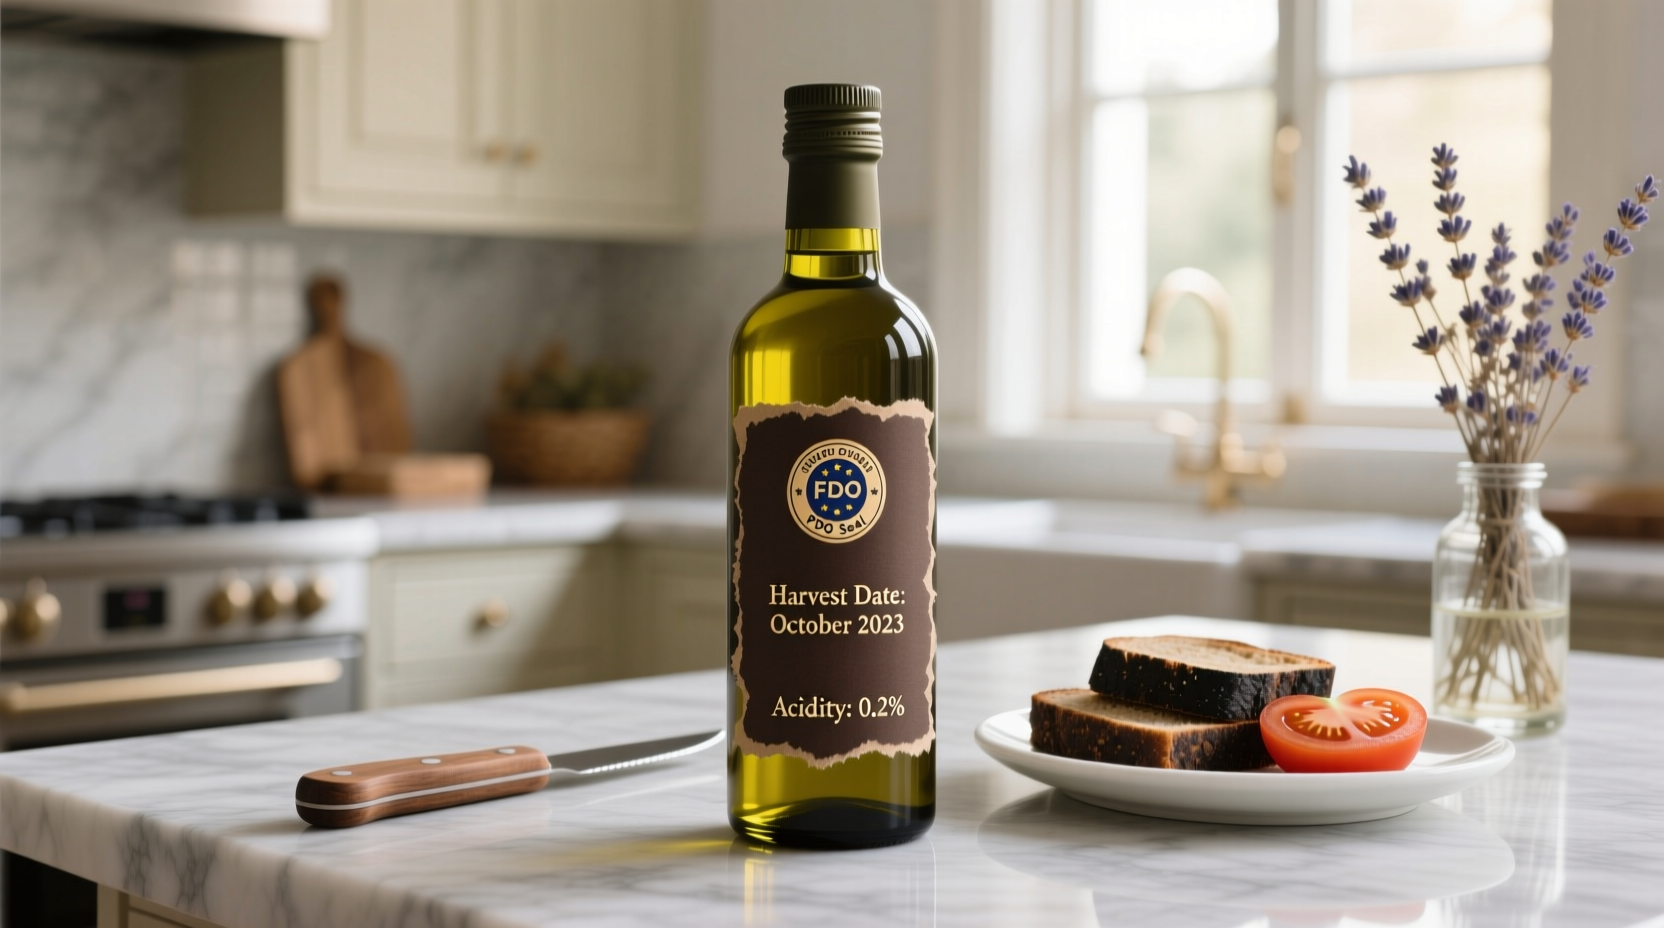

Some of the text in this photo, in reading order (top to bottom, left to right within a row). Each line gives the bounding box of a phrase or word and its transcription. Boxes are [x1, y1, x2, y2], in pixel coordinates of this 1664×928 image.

[814, 480, 862, 500] FDO
[806, 514, 834, 534] PDO
[769, 584, 906, 606] Harvest Date:
[770, 613, 905, 635] October 2023
[771, 694, 905, 725] Acidity: 0.2%
